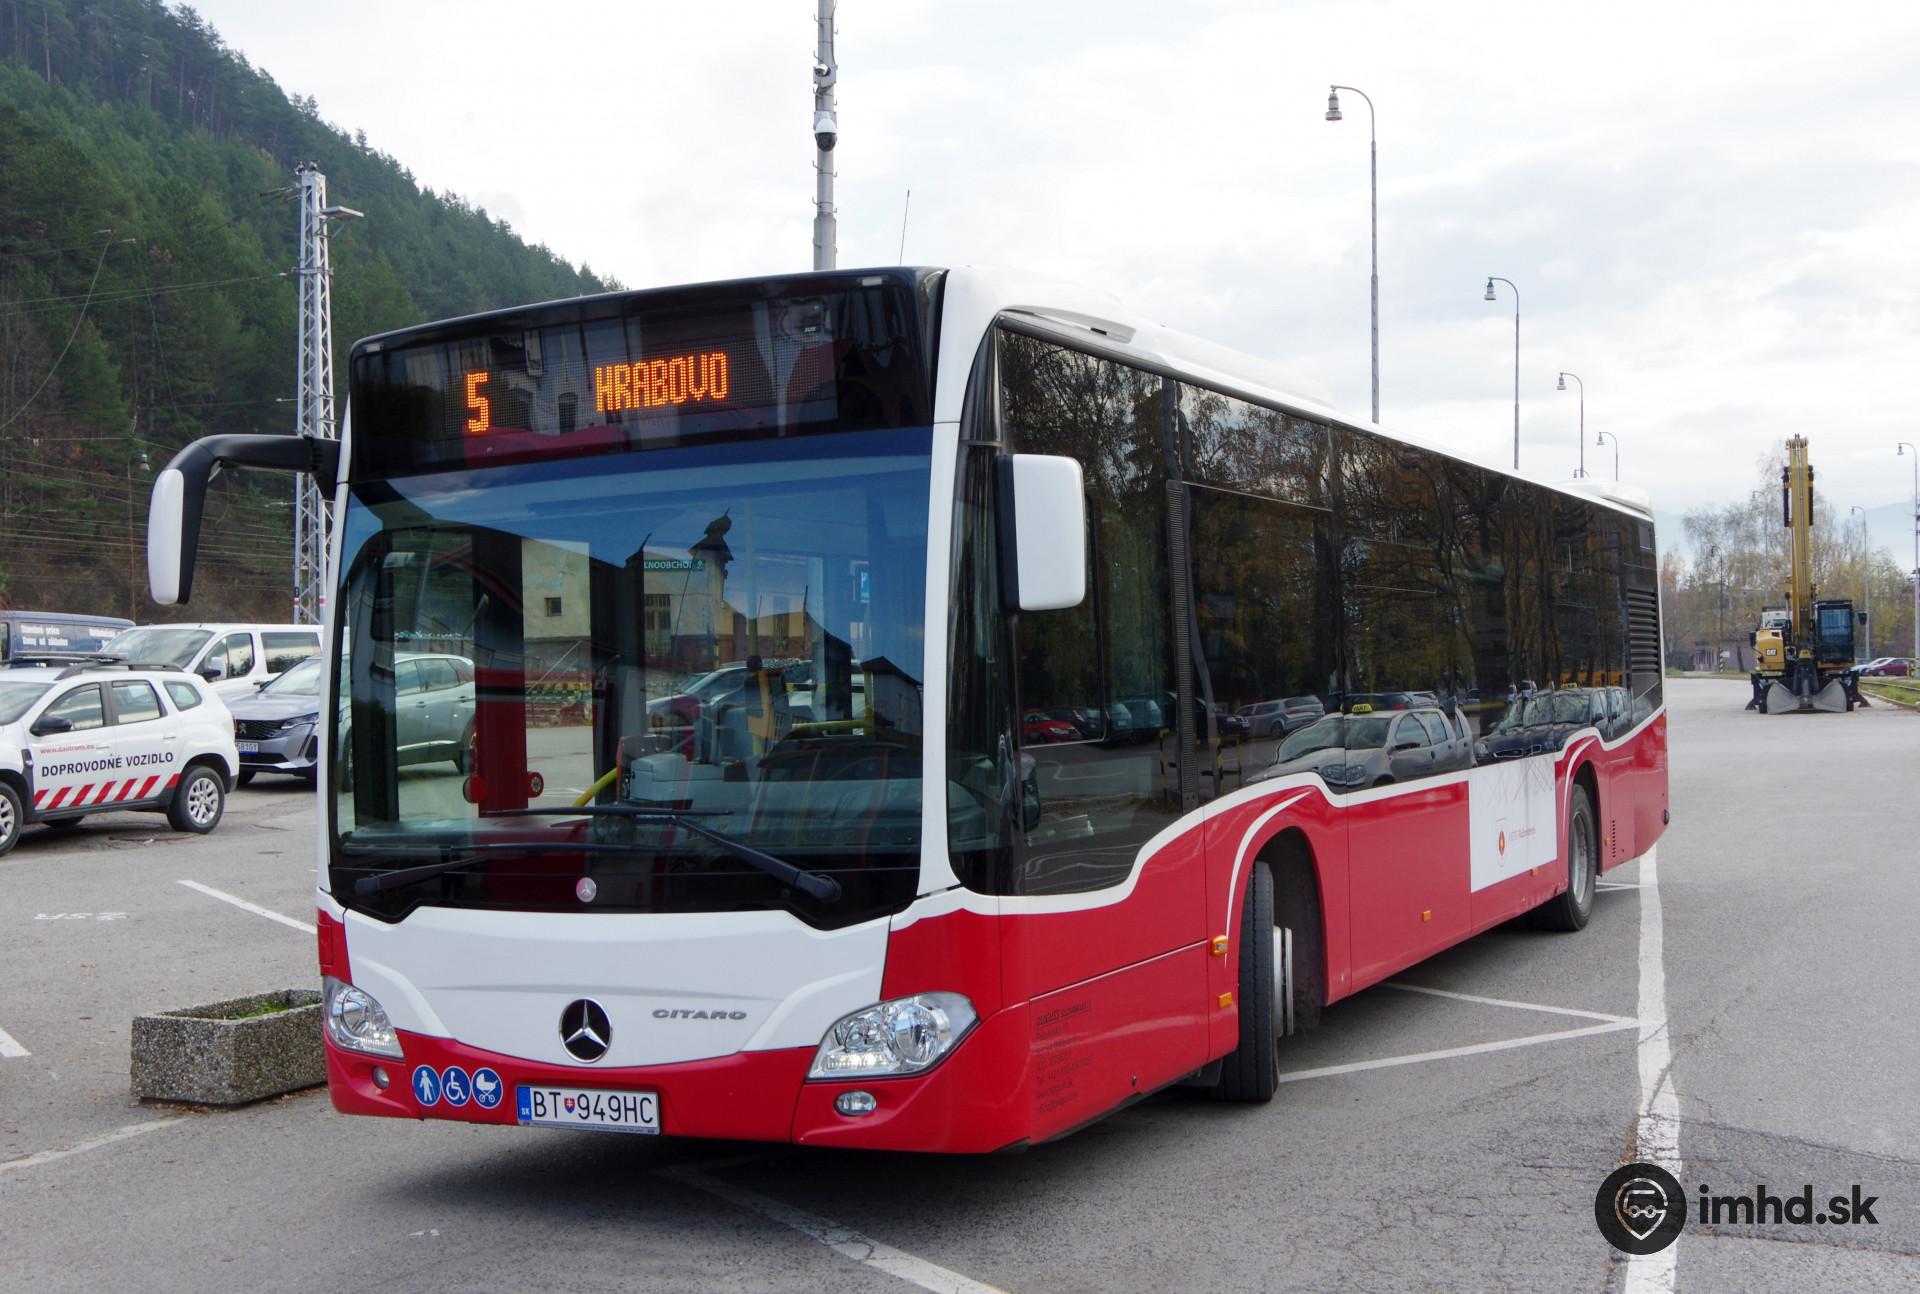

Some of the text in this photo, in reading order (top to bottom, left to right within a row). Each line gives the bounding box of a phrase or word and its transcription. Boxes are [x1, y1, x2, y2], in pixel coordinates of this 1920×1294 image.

[466, 352, 728, 432] 5 HRABOVO
[41, 751, 174, 777] DOPROVODNÉ VOZIDLO
[652, 1009, 747, 1020] CITARO
[521, 1107, 530, 1116] SK
[533, 1090, 653, 1123] BT 949HC
